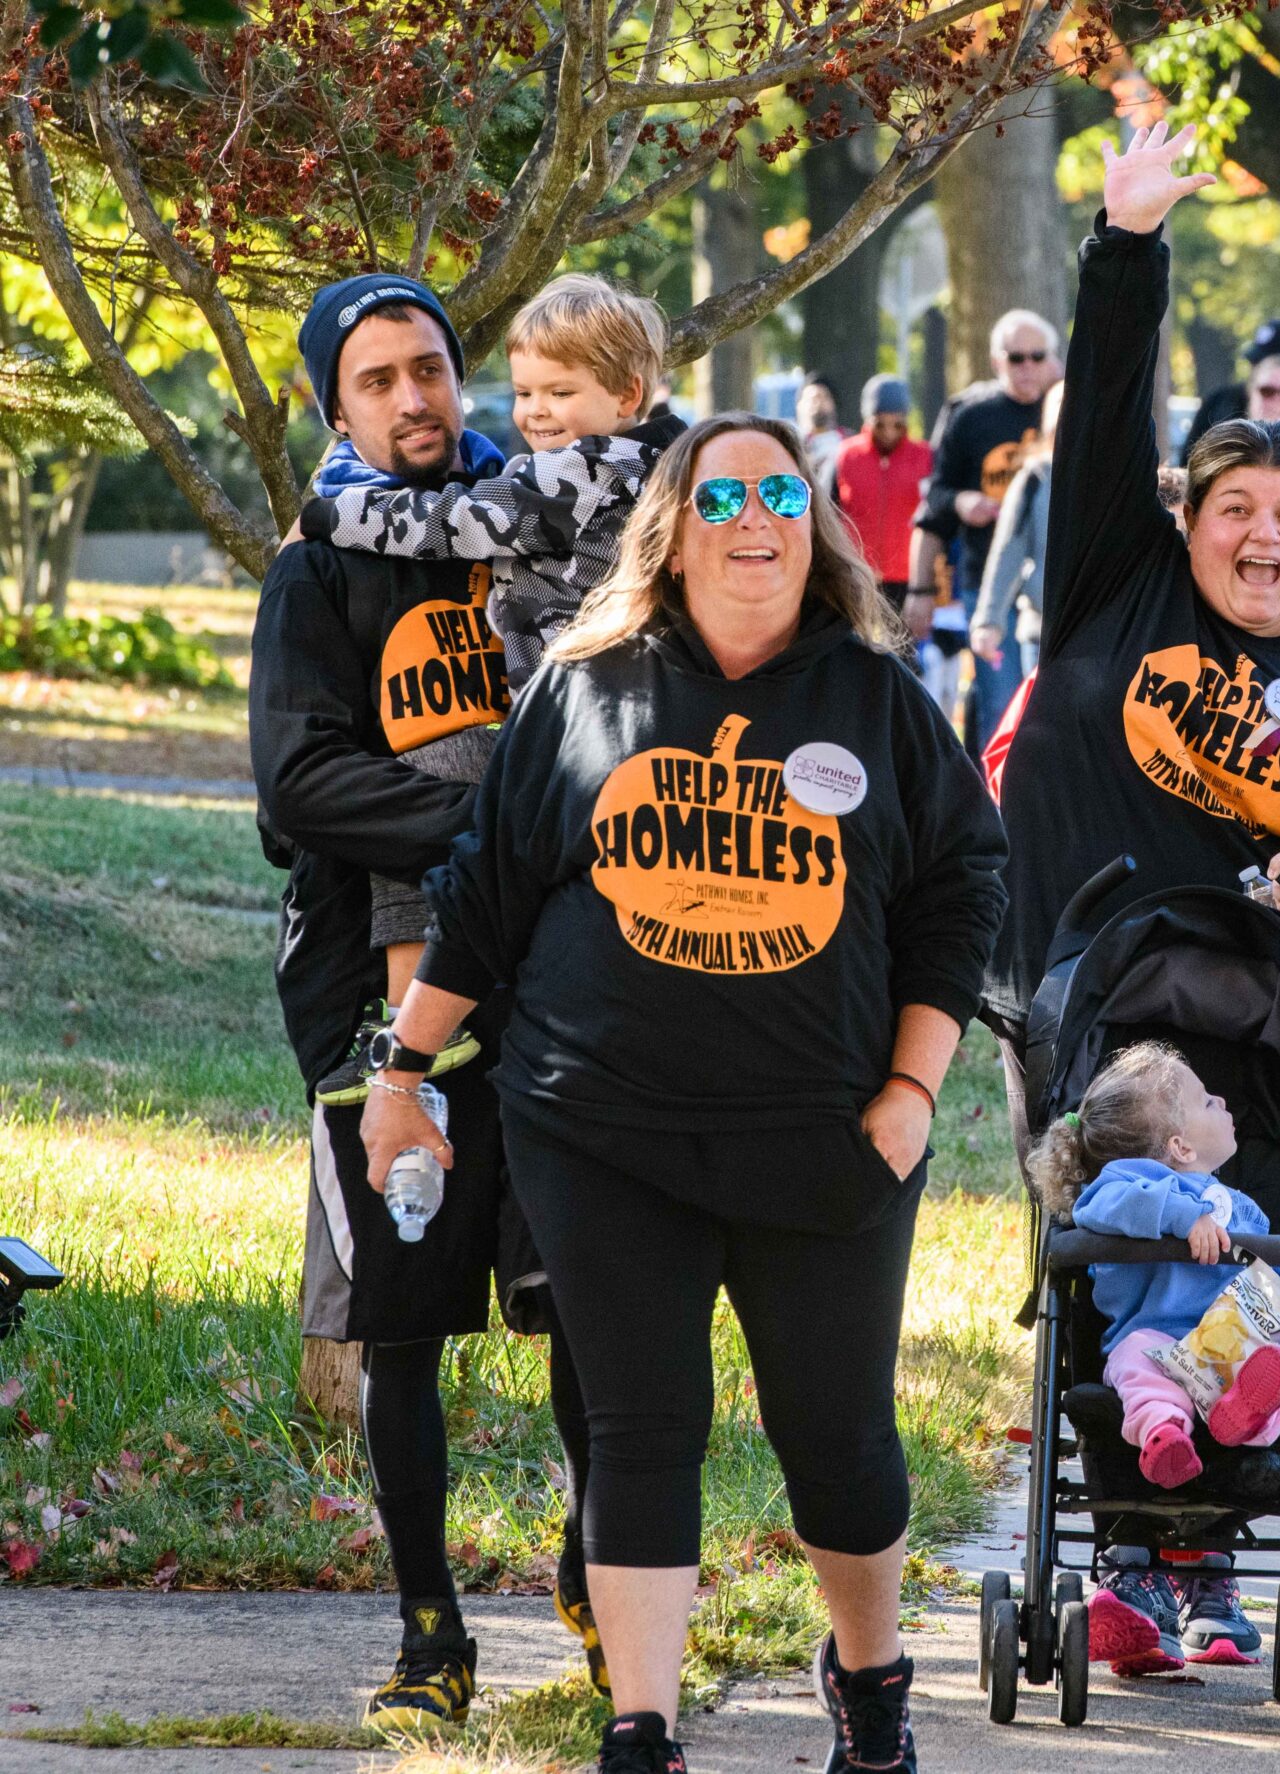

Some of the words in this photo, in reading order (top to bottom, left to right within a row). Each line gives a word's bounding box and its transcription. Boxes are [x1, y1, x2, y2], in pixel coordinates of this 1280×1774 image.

[425, 607, 492, 655] HELP
[387, 651, 510, 720] HOME
[651, 758, 729, 806] HELP
[736, 765, 788, 817] THE
[814, 773, 858, 792] CHARITABLE
[816, 764, 862, 785] united
[596, 803, 837, 887] HOMELESS
[696, 884, 727, 900] PATHWAY
[664, 927, 738, 970] ANNUAL
[738, 931, 765, 971] 5K
[759, 924, 816, 967] WALK
[1178, 1358, 1195, 1375] Salt
